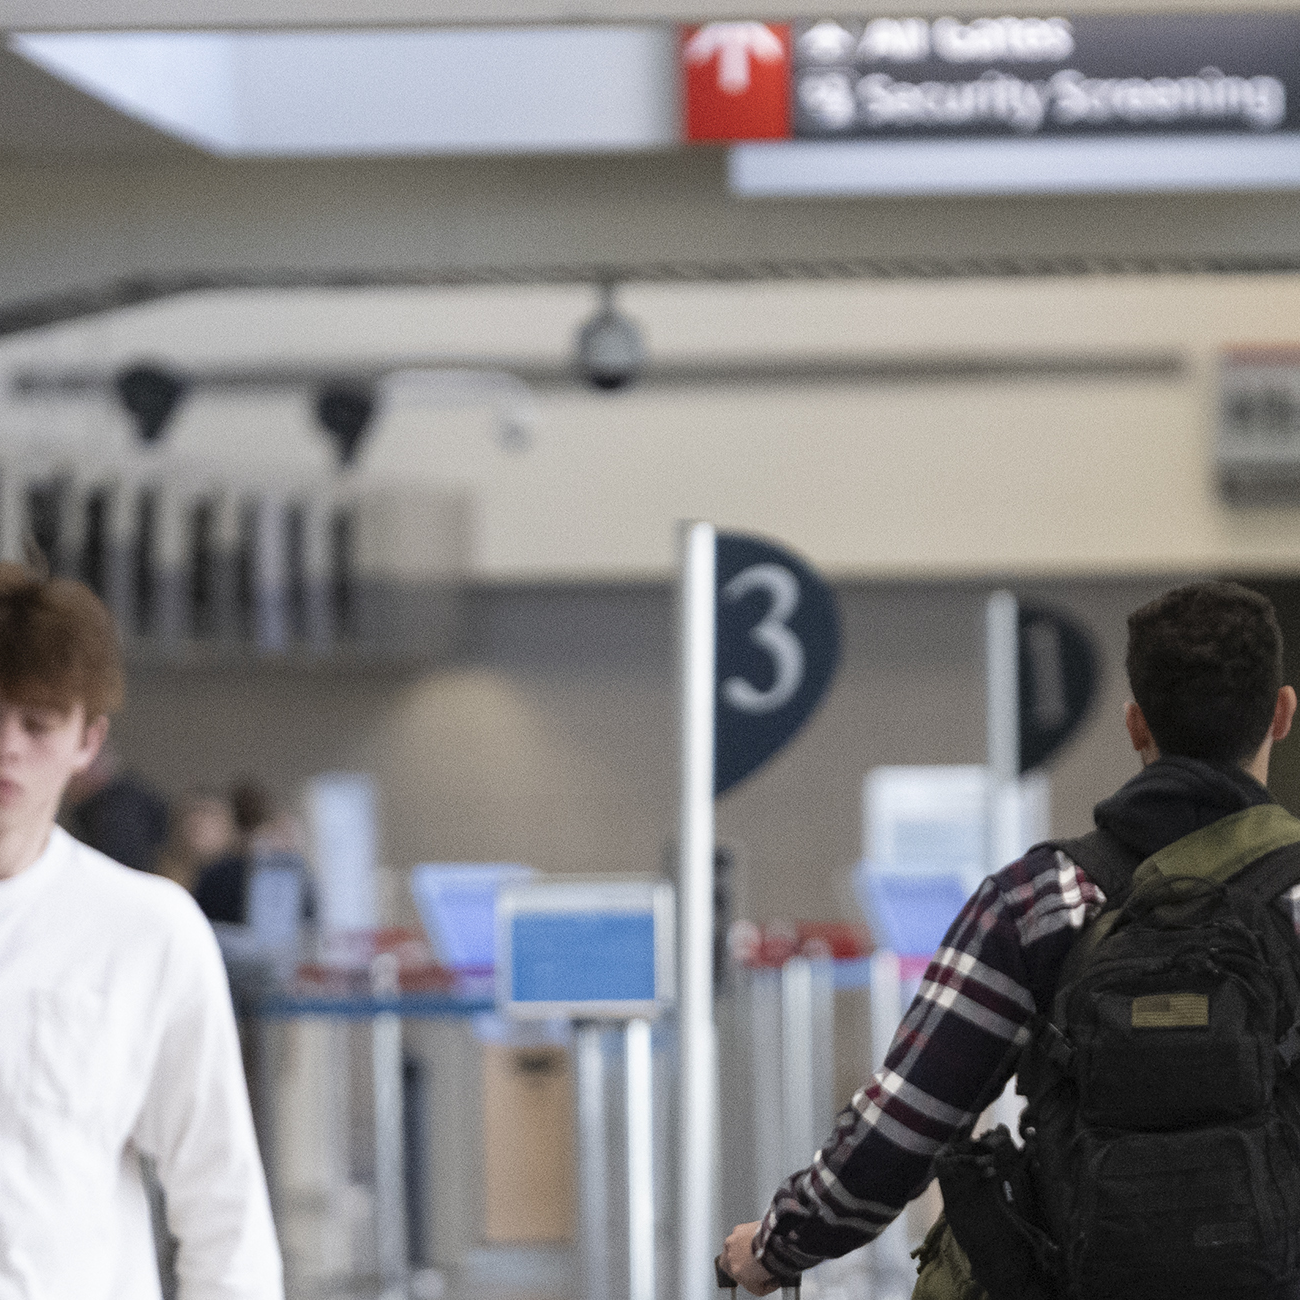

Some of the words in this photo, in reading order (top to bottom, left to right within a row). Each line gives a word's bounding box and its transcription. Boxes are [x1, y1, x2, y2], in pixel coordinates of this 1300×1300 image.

[857, 70, 1046, 133] Security
[1049, 67, 1286, 131] Screening
[722, 563, 804, 714] 3
